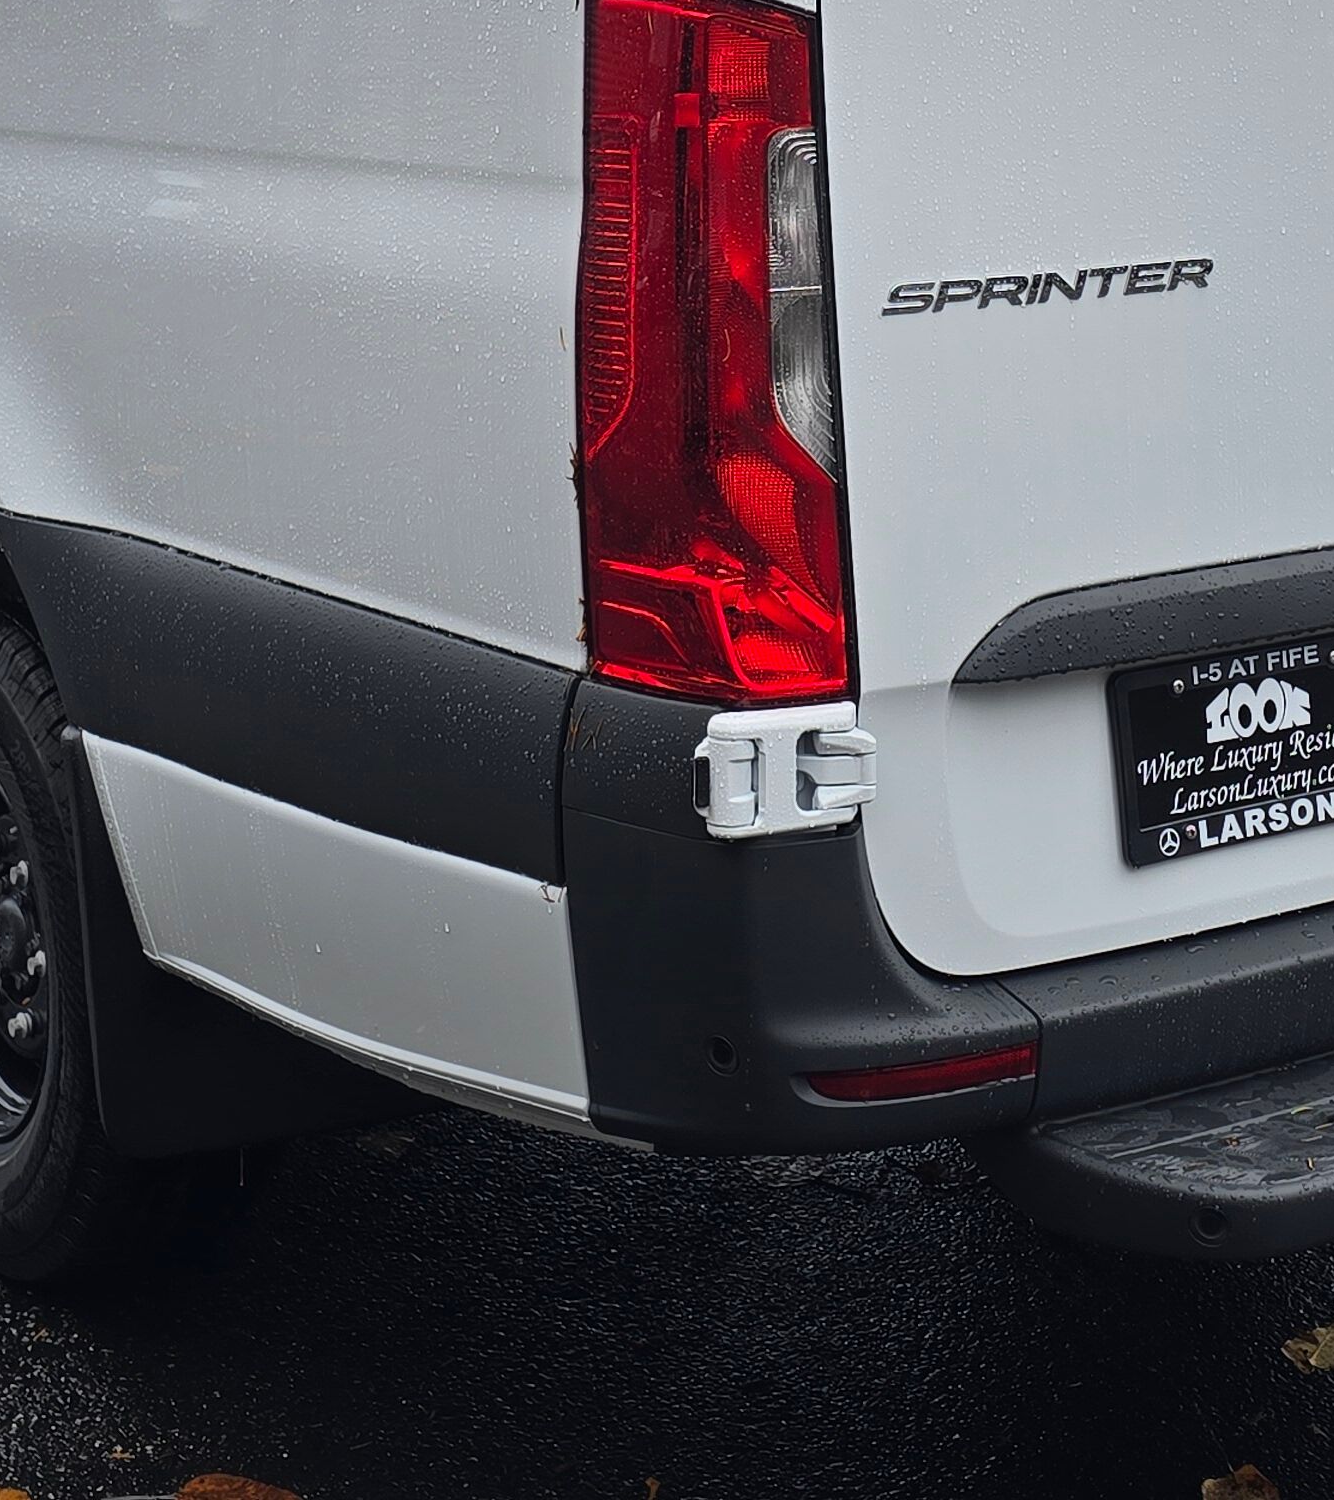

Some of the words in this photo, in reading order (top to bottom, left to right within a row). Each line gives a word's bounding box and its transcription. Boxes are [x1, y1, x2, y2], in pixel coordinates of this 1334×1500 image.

[881, 258, 1214, 316] SPRINTER
[1192, 662, 1222, 686] I-5
[1228, 655, 1259, 680] AT
[1267, 644, 1320, 672] FIFE
[1205, 677, 1312, 744] LOOK
[1137, 752, 1205, 787] Where
[1210, 739, 1284, 777] Luxury
